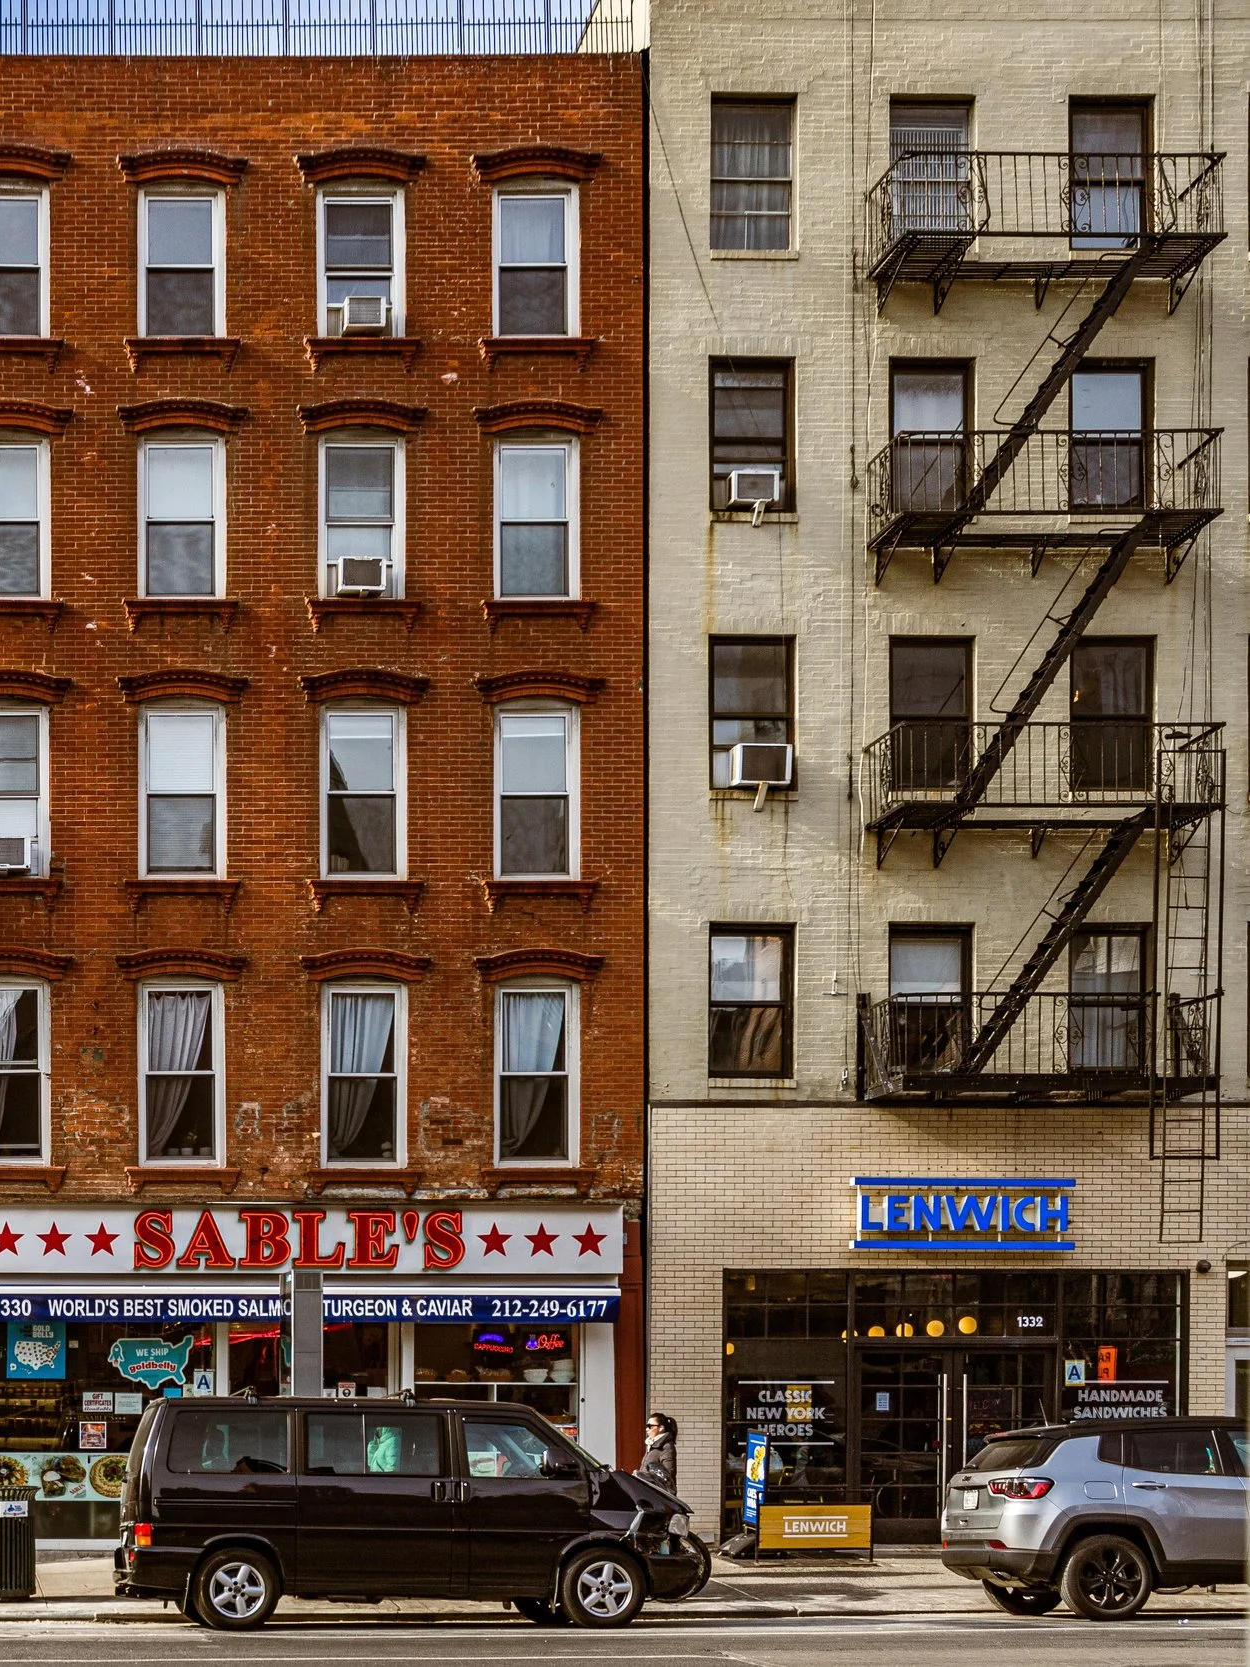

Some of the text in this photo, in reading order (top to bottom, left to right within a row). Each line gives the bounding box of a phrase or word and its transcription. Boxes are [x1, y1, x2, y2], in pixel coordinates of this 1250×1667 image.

[861, 1194, 1068, 1232] LENWICH
[133, 1209, 466, 1269] SABLE'S
[48, 1299, 119, 1317] WORLD'S
[124, 1299, 164, 1317] BEST
[168, 1299, 234, 1317] SMOKED
[238, 1299, 292, 1317] SALMO
[402, 1300, 413, 1317] &
[416, 1299, 473, 1317] CAVIAR
[491, 1299, 608, 1318] 212-249-6177
[1016, 1316, 1043, 1327] 1332
[135, 1348, 169, 1357] WE SHIP
[128, 1361, 177, 1374] goldbelly
[1067, 1365, 1081, 1380] A
[196, 1374, 211, 1389] A
[758, 1390, 812, 1403] CLASSIC
[1078, 1389, 1163, 1402] HANDMADE
[746, 1407, 826, 1419] NEW YORK
[1073, 1406, 1168, 1419] SANDWICHES
[784, 1521, 846, 1533] LENWICH
